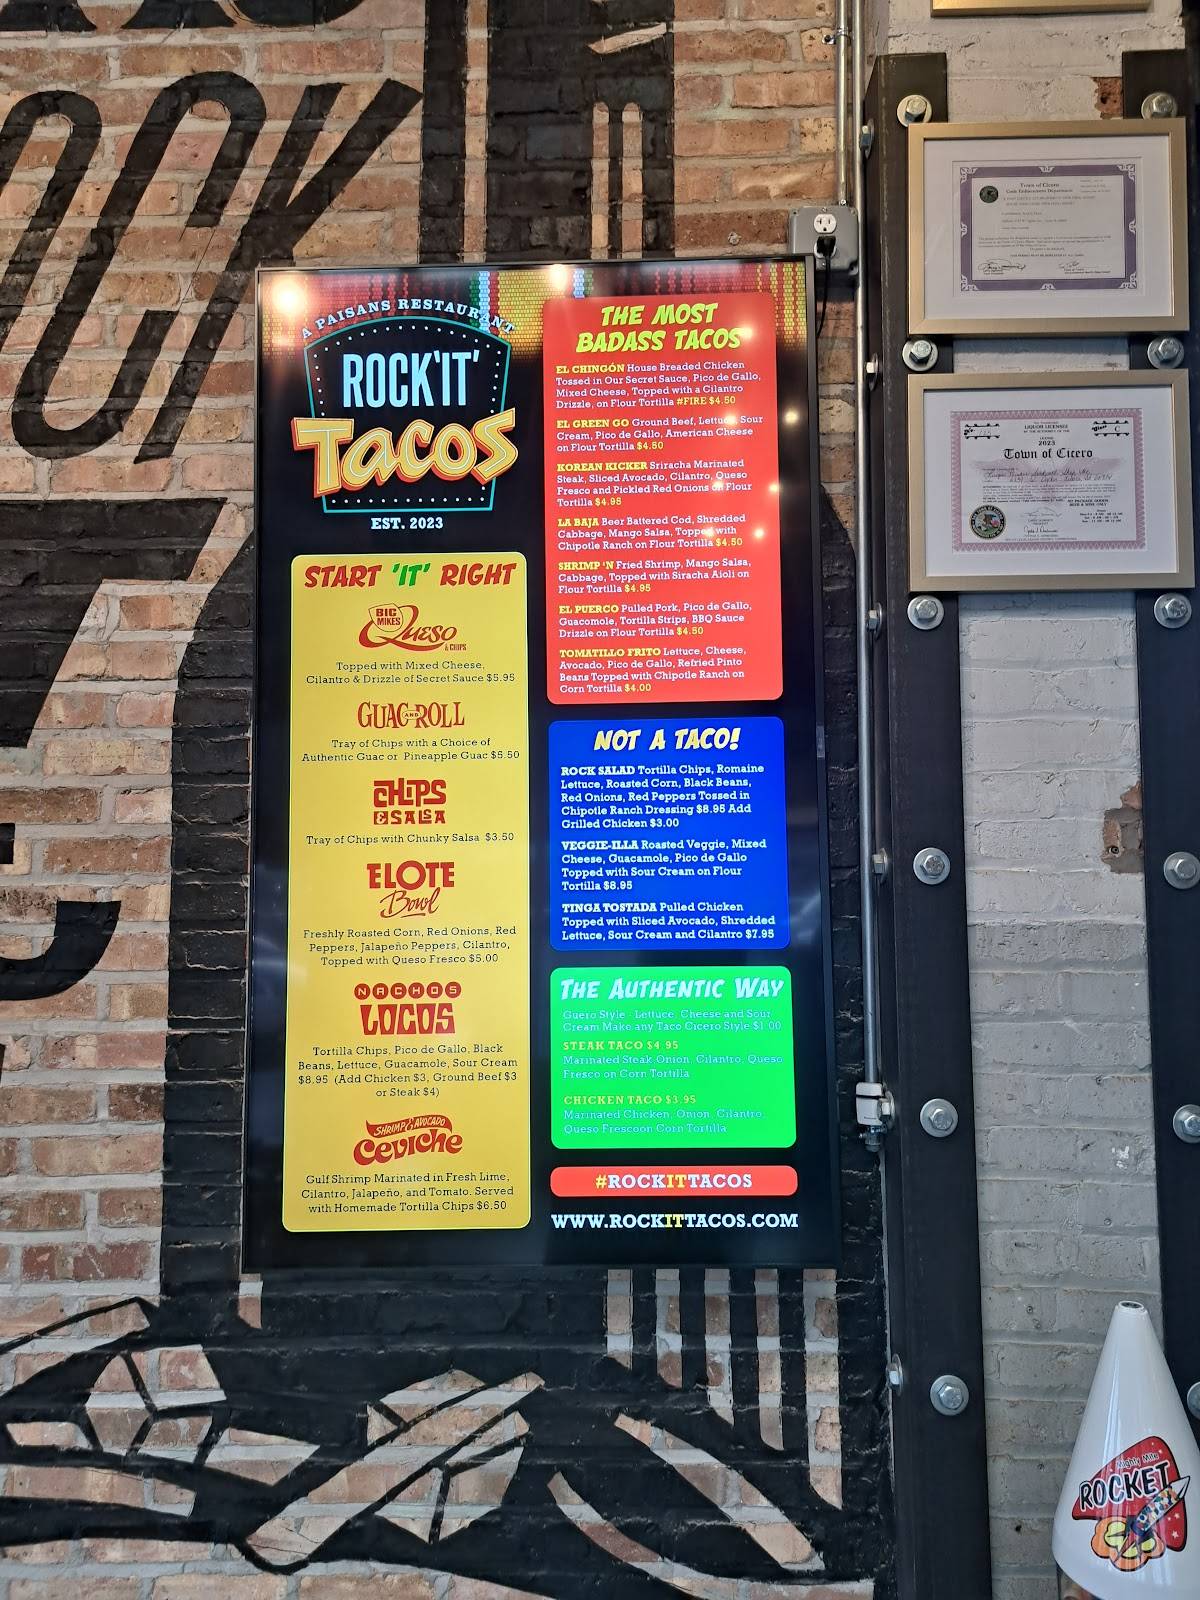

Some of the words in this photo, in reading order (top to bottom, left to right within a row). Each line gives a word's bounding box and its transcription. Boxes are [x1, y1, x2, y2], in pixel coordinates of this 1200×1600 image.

[302, 327, 313, 339] A
[315, 300, 391, 330] PAISANS
[398, 299, 515, 334] RESTAURANT
[601, 305, 645, 327] THE
[652, 303, 719, 325] MOST
[575, 330, 667, 353] BADASS
[674, 327, 742, 351] TACOS
[555, 365, 569, 374] EL
[571, 362, 625, 373] CHINGÓN
[627, 363, 657, 372] House
[659, 361, 701, 371] Breaded
[703, 360, 744, 370] Chicken
[556, 399, 593, 408] Drizzle,
[610, 398, 636, 407] Flour
[638, 397, 674, 406] Tortilla
[676, 396, 707, 406] #FIRE
[1004, 448, 1037, 459] Town
[1042, 448, 1052, 458] of
[1056, 447, 1093, 458] Cicero
[556, 462, 603, 472] KOREAN
[605, 461, 648, 471] KICKER
[649, 460, 691, 469] Sriracha
[693, 459, 744, 468] Marinated
[370, 517, 406, 530] EST.
[410, 517, 444, 529] 2023
[557, 518, 572, 527] LA
[573, 517, 600, 528] BAJA
[601, 517, 625, 526] Beer
[626, 515, 669, 525] Battered
[670, 515, 694, 524] Cod,
[696, 513, 746, 523] Shredded
[304, 564, 383, 589] START
[440, 562, 517, 587] RIGHT
[375, 608, 397, 617] BIG
[558, 605, 572, 614] EL
[574, 604, 619, 614] PUERCO
[621, 603, 653, 613] Pulled
[655, 603, 680, 612] Pork,
[683, 602, 704, 611] Pico
[706, 602, 719, 610] de
[721, 601, 751, 610] Gallo,
[377, 617, 401, 626] MIKES
[559, 648, 625, 658] TOMATILLO
[627, 647, 661, 656] FRITO
[663, 647, 702, 656] Lettuce,
[705, 646, 746, 654] Cheese,
[336, 661, 377, 672] Topped
[380, 661, 402, 670] with
[405, 661, 439, 670] Mixed
[441, 660, 484, 669] Cheese,
[306, 675, 350, 684] Cilantro
[352, 675, 360, 683] &
[363, 674, 401, 683] Drizzle
[403, 674, 414, 682] of
[416, 674, 450, 683] Secret
[452, 673, 484, 682] Sauce
[486, 672, 515, 682] $5.95
[559, 684, 585, 693] Corn
[586, 683, 622, 693] Tortilla
[624, 683, 651, 693] $4.00
[357, 701, 409, 729] GUAC
[414, 702, 465, 729] ROLL
[594, 729, 642, 751] NOT
[649, 729, 666, 751] A
[674, 727, 741, 750] TACO!
[560, 766, 596, 776] ROCK
[598, 765, 635, 775] SALAD
[637, 765, 677, 774] Tortilla
[678, 764, 714, 776] Chips,
[716, 763, 764, 773] Romaine
[390, 809, 446, 825] SALSA
[561, 805, 607, 817] Chipotle
[609, 804, 643, 815] Ranch
[644, 804, 694, 816] Dressing
[695, 803, 726, 814] $8.95
[727, 803, 752, 813] Add
[561, 818, 600, 828] Grilled
[602, 818, 648, 828] Chicken
[649, 817, 679, 828] $3.00
[305, 835, 331, 846] Tray
[333, 835, 344, 844] of
[347, 834, 378, 845] Chips
[381, 834, 404, 843] with
[406, 833, 449, 844] Chunky
[452, 832, 479, 842] Salsa
[485, 832, 514, 842] $3.50
[560, 839, 639, 850] VEGGIE-ILLA
[640, 839, 684, 849] Roasted
[685, 839, 729, 851] Veggie,
[731, 838, 767, 848] Mixed
[366, 860, 455, 891] ELOTE
[379, 887, 441, 918] Bowl
[561, 902, 601, 913] TINGA
[602, 902, 657, 912] TOSTADA
[659, 902, 695, 911] Pulled
[697, 901, 744, 911] Chicken
[561, 930, 605, 941] Lettuce,
[607, 930, 633, 939] Sour
[635, 929, 672, 939] Cream
[674, 929, 696, 939] and
[697, 929, 743, 938] Cilantro
[745, 928, 774, 939] $7.95
[355, 983, 461, 999] NACHOS
[359, 1003, 456, 1035] LOCOS
[563, 1040, 604, 1050] STEAK
[607, 1040, 643, 1050] TACO
[563, 1095, 624, 1105] CHICKEN
[627, 1095, 662, 1104] TACO
[374, 1122, 406, 1137] SHRIMP
[414, 1117, 446, 1129] AVOCADO
[305, 1174, 329, 1184] Gulf
[331, 1174, 371, 1185] Shrimp
[374, 1172, 430, 1183] Marinated
[445, 1172, 476, 1181] Fresh
[479, 1171, 509, 1182] Lime,
[595, 1173, 752, 1189] #ROCKITTACOS
[308, 1203, 332, 1213] with
[334, 1202, 396, 1212] Homemade
[399, 1201, 439, 1211] Tortilla
[441, 1201, 474, 1212] Chips
[476, 1200, 506, 1211] $6.50
[550, 1213, 799, 1229] WWW.ROCKITTACOS.COM
[1079, 1461, 1170, 1512] ROCKET
